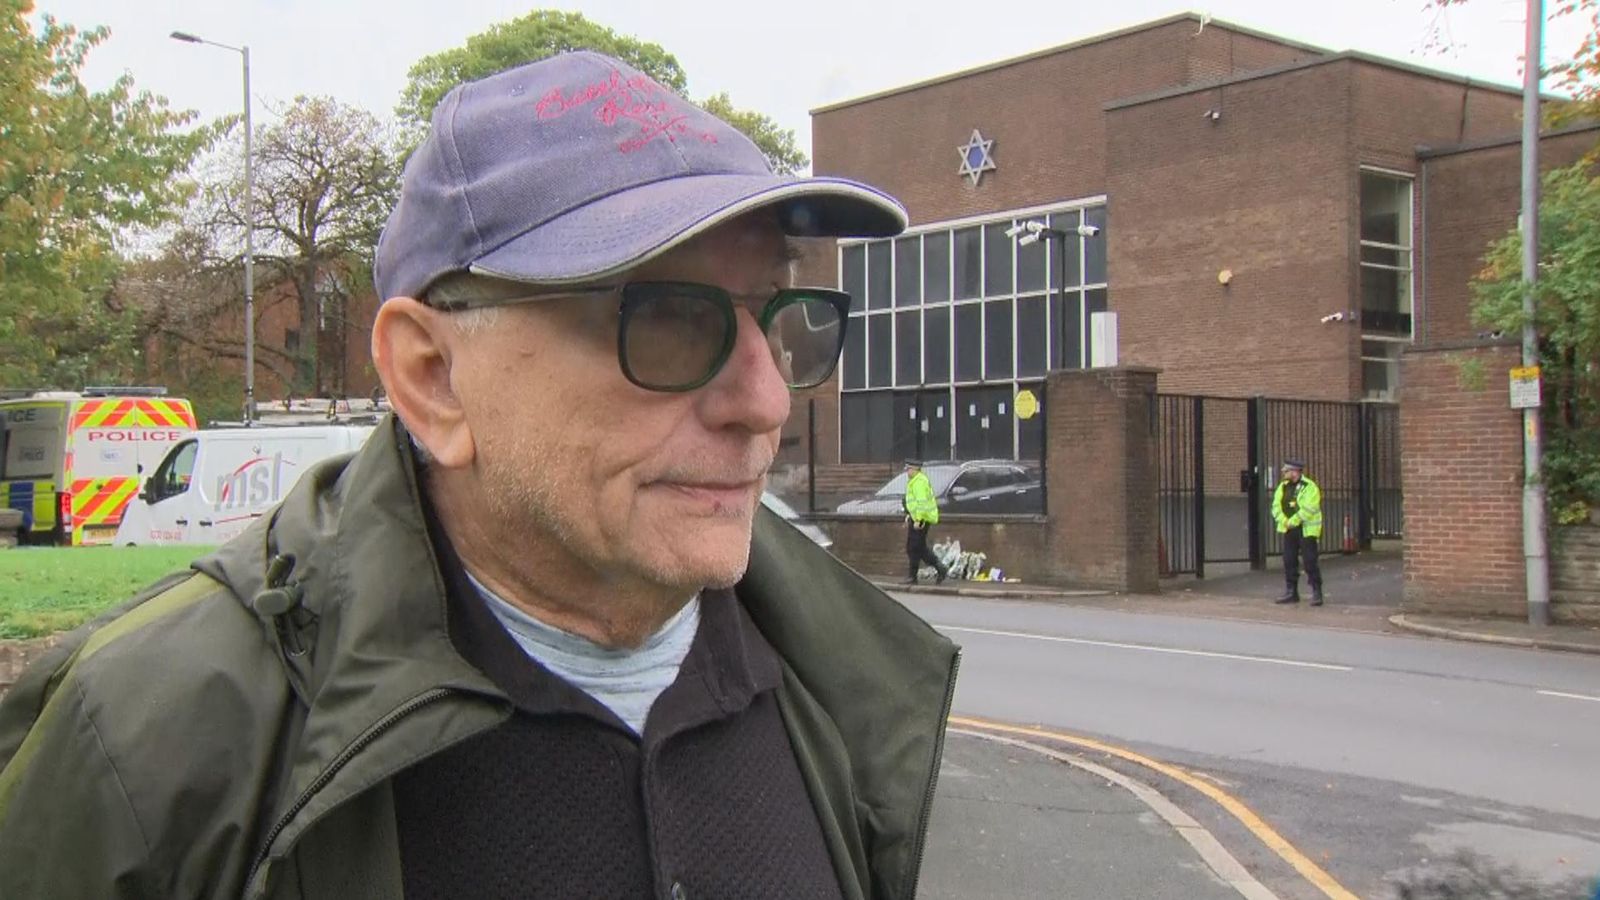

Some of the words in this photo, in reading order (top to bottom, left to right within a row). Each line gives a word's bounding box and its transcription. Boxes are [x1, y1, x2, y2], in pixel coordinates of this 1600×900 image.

[8, 408, 37, 422] ICE
[88, 431, 181, 441] POLICE
[215, 451, 282, 512] msl
